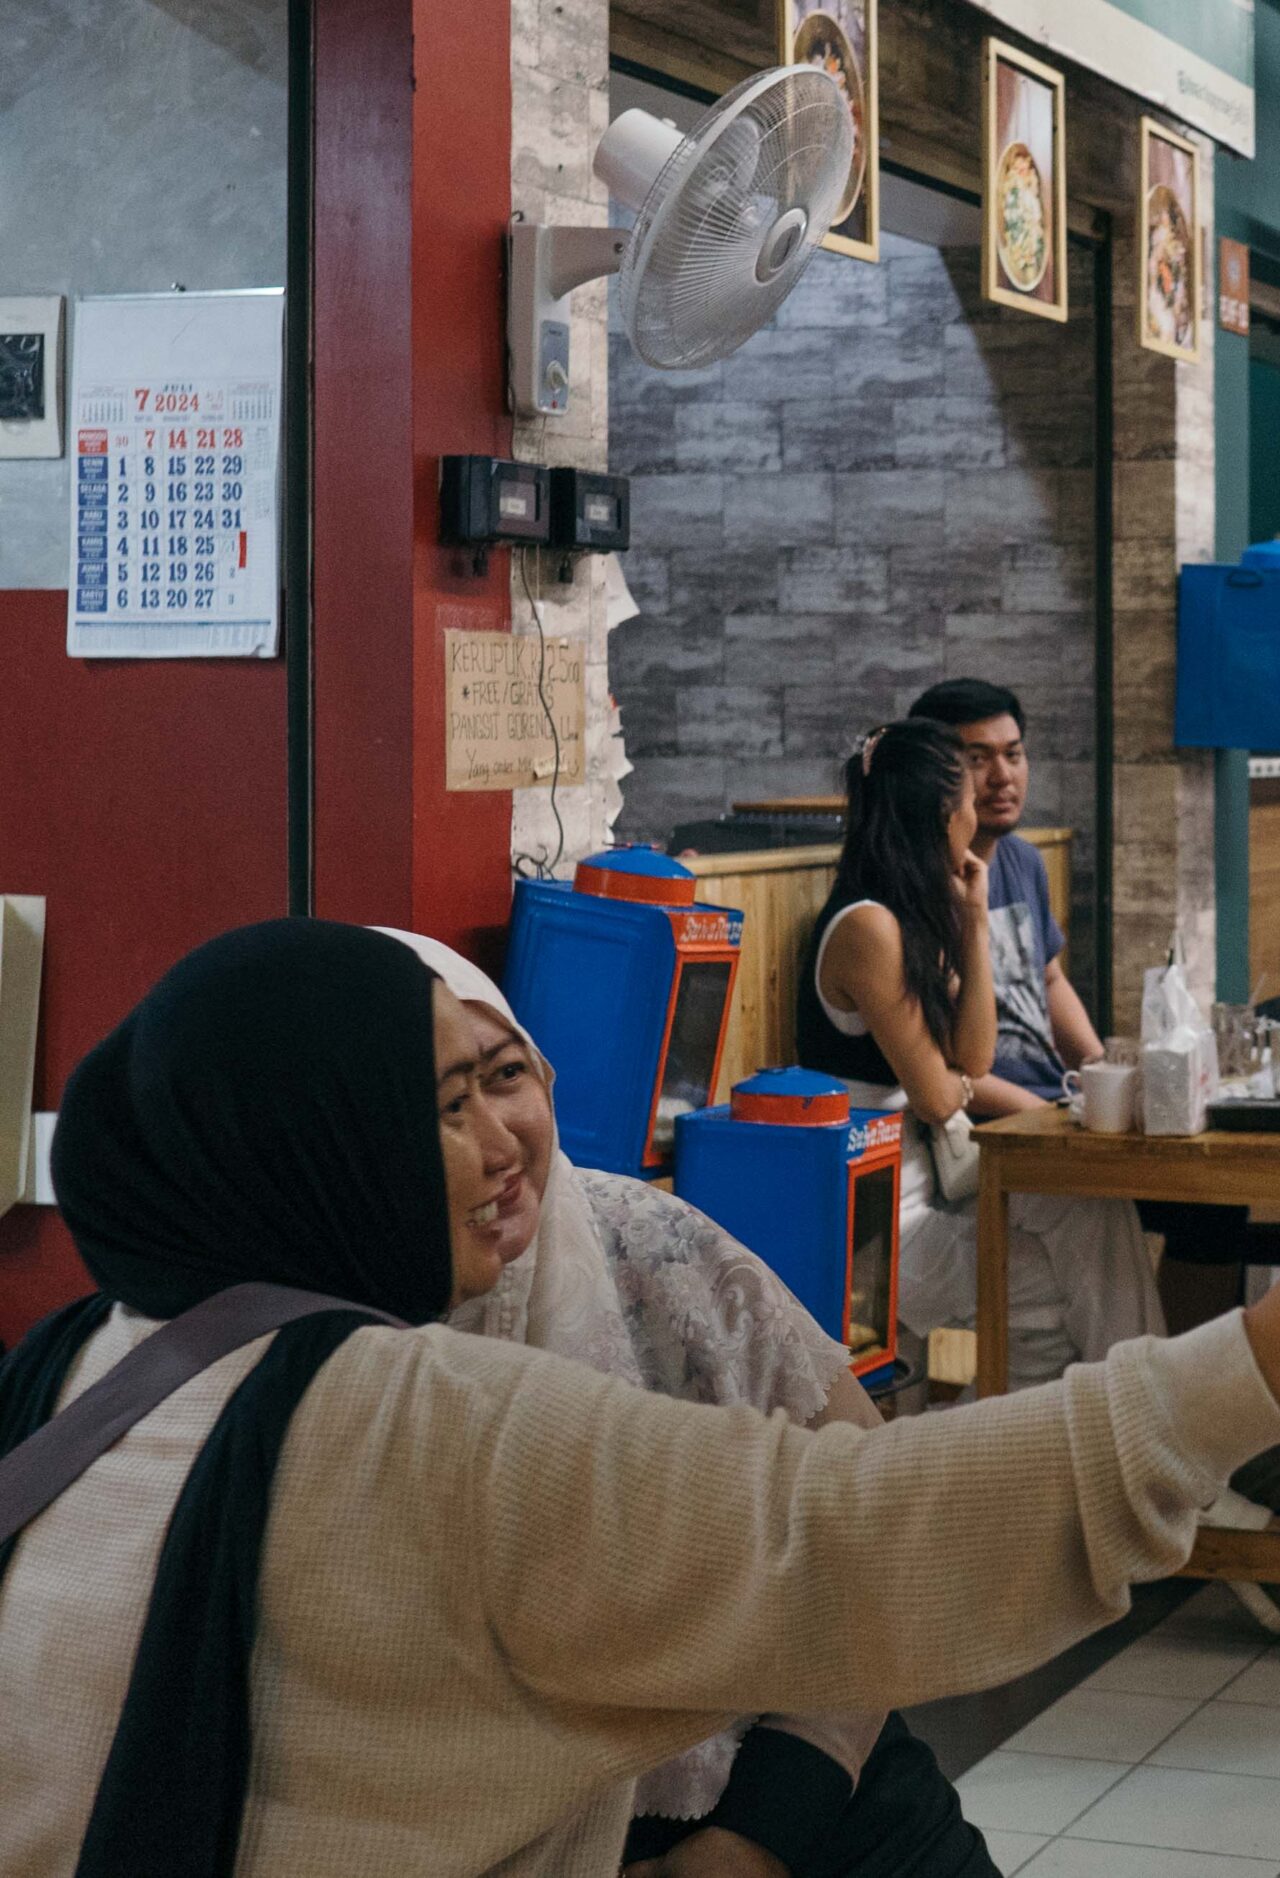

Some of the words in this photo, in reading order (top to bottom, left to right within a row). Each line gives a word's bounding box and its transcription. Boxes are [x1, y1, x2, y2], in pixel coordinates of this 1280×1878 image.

[134, 388, 149, 412] 7
[155, 393, 199, 412] 2024
[144, 429, 155, 449] 7
[168, 428, 187, 449] 14
[196, 428, 216, 448] 21
[223, 428, 243, 448] 28
[119, 456, 126, 476] 1
[144, 456, 154, 475] 8
[168, 456, 186, 475] 15
[194, 456, 215, 475] 22
[222, 456, 242, 475] 29
[118, 484, 129, 502] 2
[145, 483, 155, 501] 9
[168, 482, 187, 501] 16
[194, 482, 214, 500] 23
[222, 482, 242, 500] 30
[117, 510, 128, 529] 3
[141, 510, 159, 529] 10
[168, 510, 186, 529] 17
[194, 510, 214, 529] 24
[222, 509, 241, 528] 31
[117, 536, 128, 556] 4
[142, 536, 159, 556] 11
[168, 536, 187, 556] 18
[195, 536, 214, 555] 25
[118, 563, 128, 582] 5
[141, 563, 160, 582] 12
[168, 562, 187, 582] 19
[194, 562, 214, 581] 26
[117, 589, 128, 608] 6
[141, 589, 160, 608] 13
[167, 589, 187, 608] 20
[194, 589, 214, 608] 27
